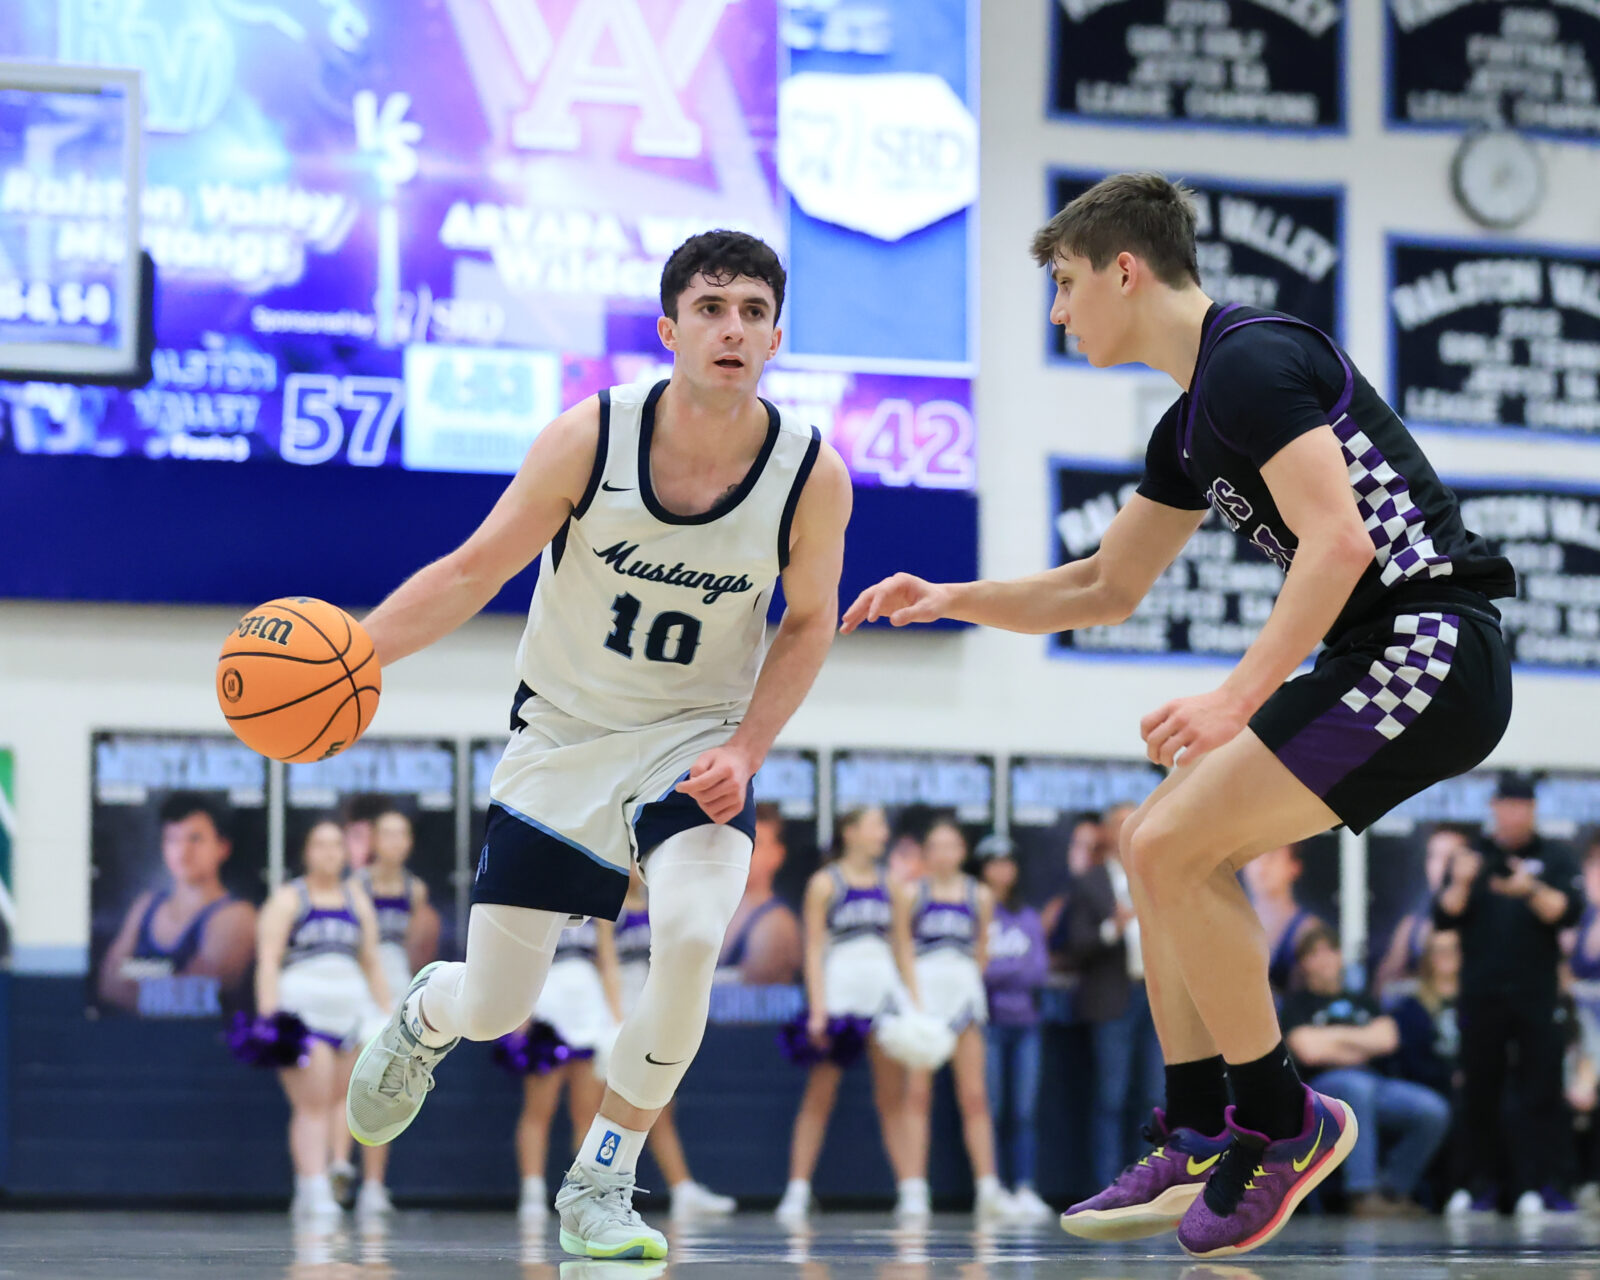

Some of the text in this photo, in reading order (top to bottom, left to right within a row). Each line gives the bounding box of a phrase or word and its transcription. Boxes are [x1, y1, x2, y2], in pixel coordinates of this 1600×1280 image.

[1219, 195, 1338, 281] VALLEY
[1393, 259, 1542, 332] RALSTON
[280, 371, 405, 468] 57
[849, 398, 976, 487] 42
[592, 540, 754, 605] Mustangs
[603, 591, 702, 666] 10
